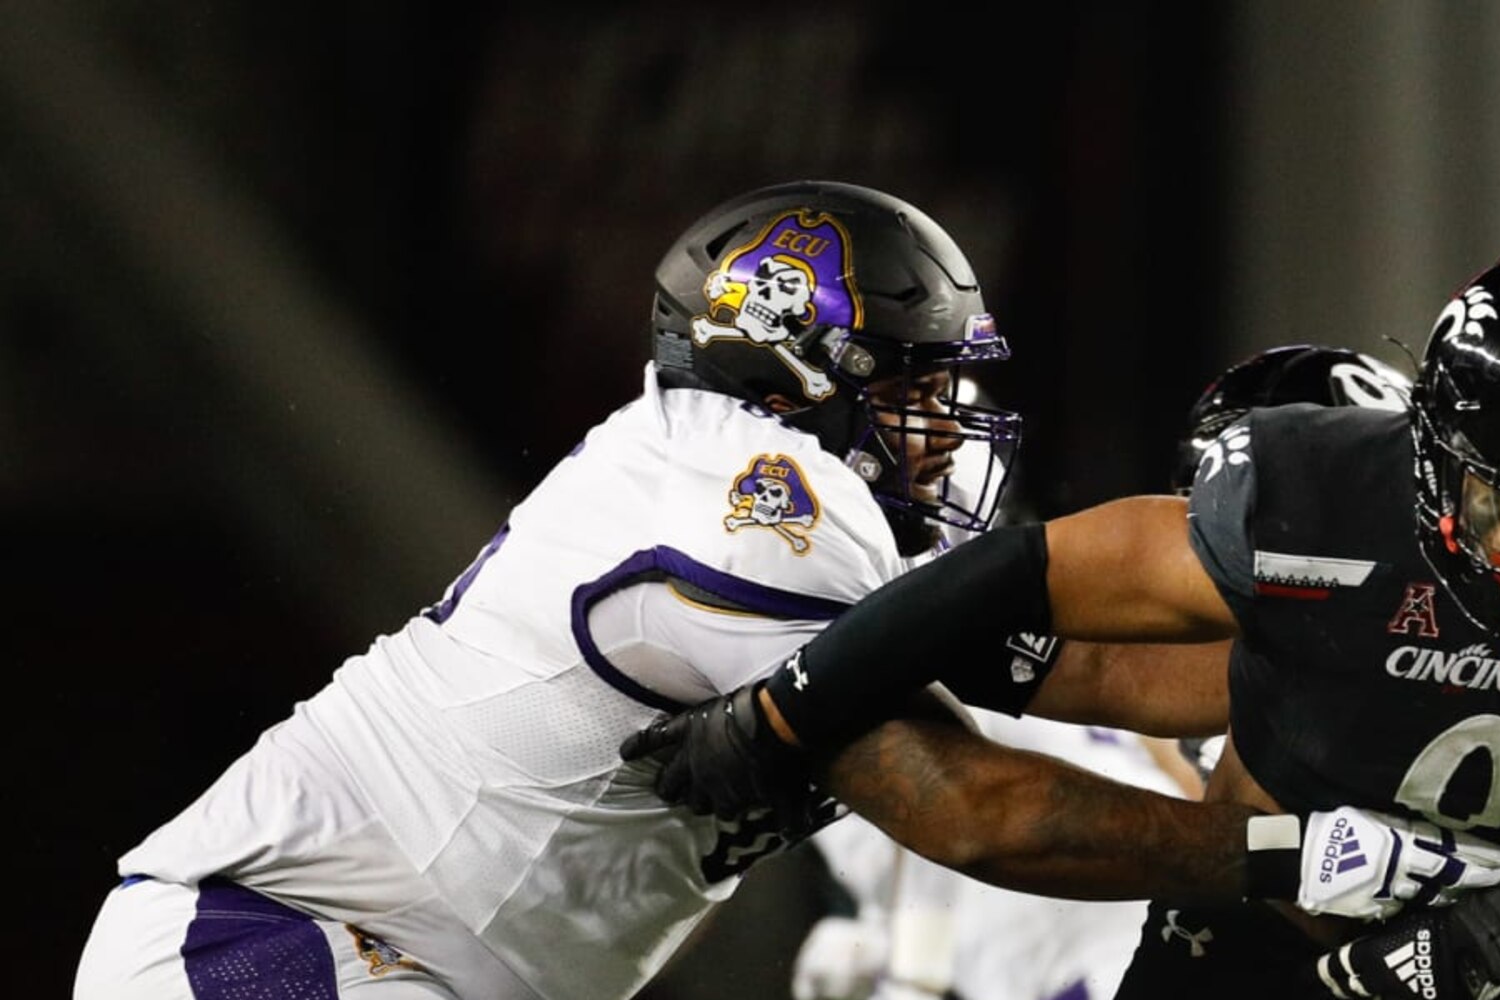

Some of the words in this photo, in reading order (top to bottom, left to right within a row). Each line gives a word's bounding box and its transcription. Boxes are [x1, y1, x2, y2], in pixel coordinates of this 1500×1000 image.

[772, 229, 829, 257] ECU
[759, 464, 790, 478] ECU
[1319, 817, 1348, 885] adidas
[1413, 928, 1437, 1000] adidas
